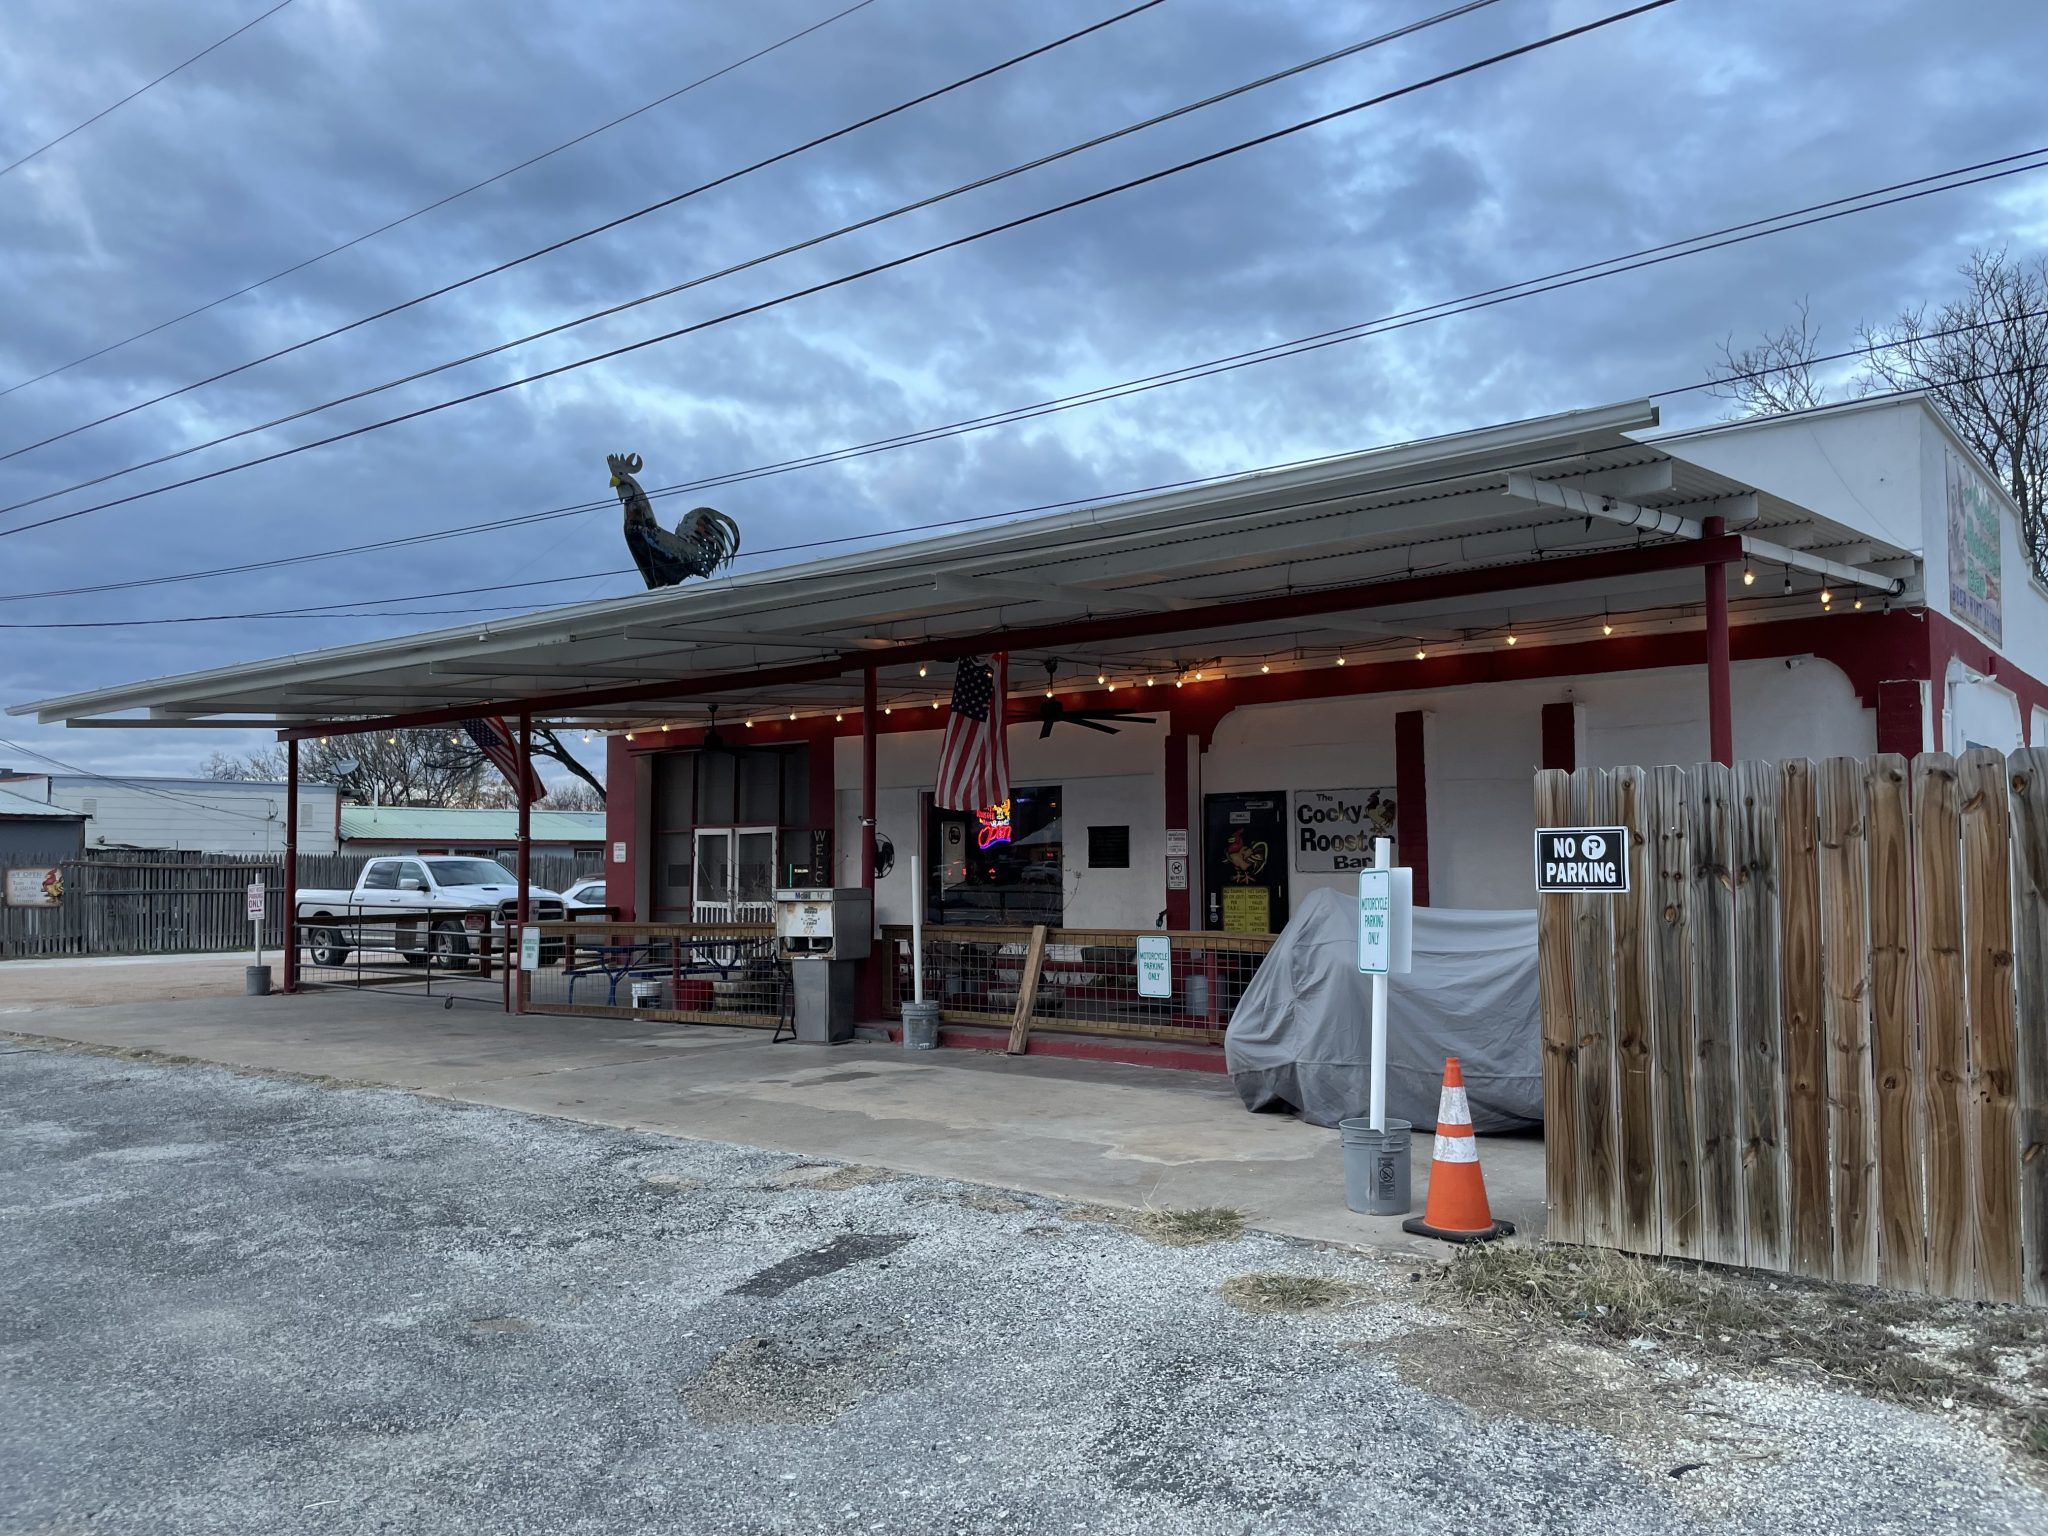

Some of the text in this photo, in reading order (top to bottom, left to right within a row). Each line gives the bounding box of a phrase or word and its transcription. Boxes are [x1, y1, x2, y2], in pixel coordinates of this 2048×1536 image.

[1316, 794, 1333, 802] The
[1297, 801, 1362, 824] Cocky
[1553, 837, 1576, 858] NO
[814, 830, 826, 887] WELC
[1334, 856, 1372, 869] Bar
[1546, 861, 1616, 883] PARKING
[249, 900, 263, 908] ONLY
[1361, 897, 1387, 910] MOTORCYCLE
[1364, 915, 1383, 927] PARKING
[1368, 932, 1379, 944] ONLY
[1140, 952, 1167, 960] MOTORCYCLE
[1144, 962, 1164, 970] PARKING
